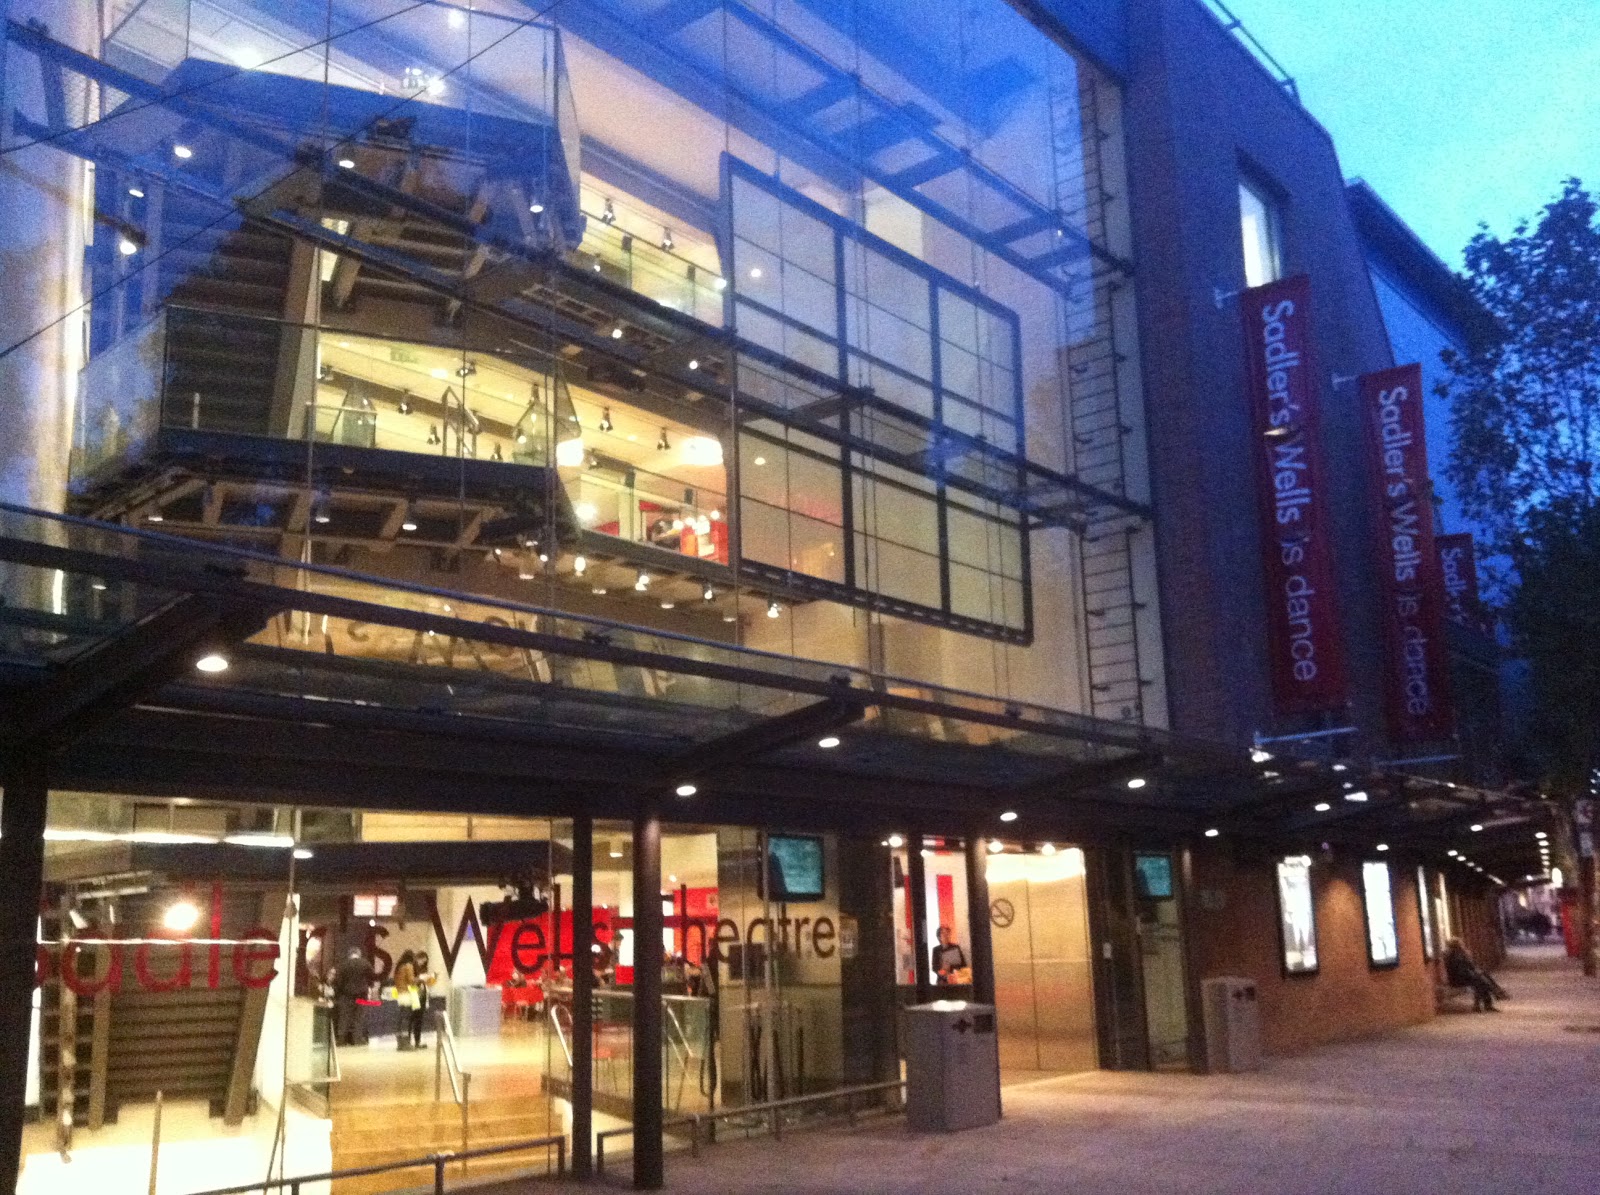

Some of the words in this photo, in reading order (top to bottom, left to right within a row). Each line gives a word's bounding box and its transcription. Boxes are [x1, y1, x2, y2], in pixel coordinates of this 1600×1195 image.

[1262, 299, 1299, 426] Sadler's
[1271, 440, 1311, 525] Wells
[1378, 385, 1413, 498] Sadler's
[1389, 502, 1422, 581] Wells
[1285, 575, 1318, 682] dance
[1404, 626, 1429, 715] dance
[428, 883, 612, 977] Wels
[655, 884, 837, 966] heatre
